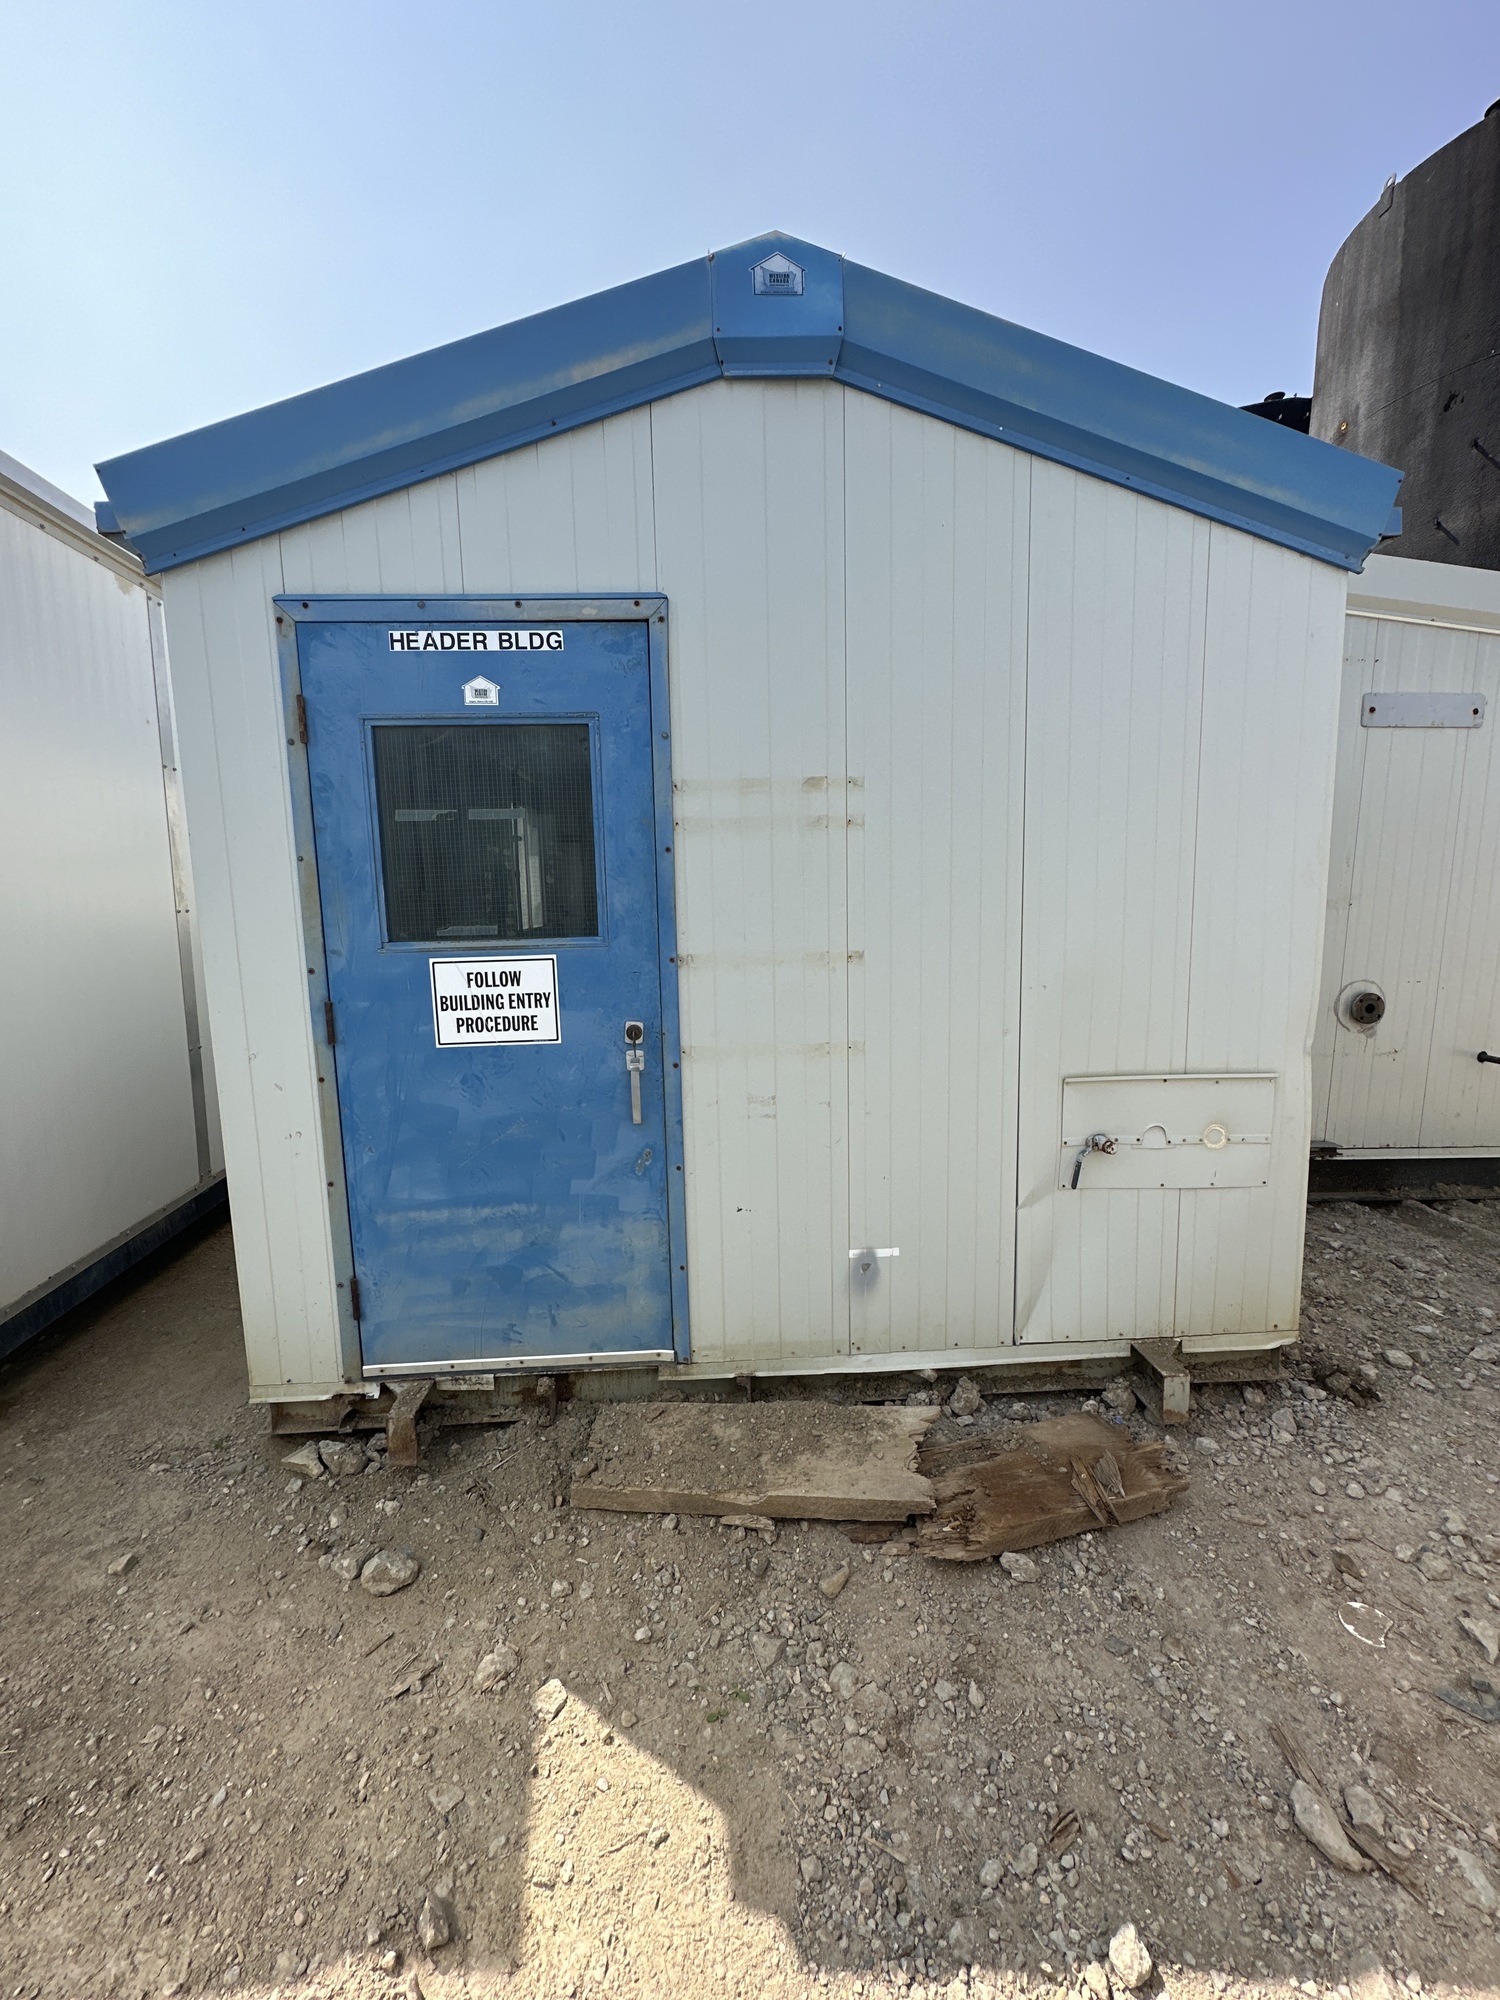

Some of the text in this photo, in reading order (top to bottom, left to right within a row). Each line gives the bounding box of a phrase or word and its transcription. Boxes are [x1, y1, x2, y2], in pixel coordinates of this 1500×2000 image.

[389, 632, 563, 650] HEADER BLDG
[466, 970, 521, 988] FOLLOW
[440, 992, 551, 1012] BUILDING ENTRY
[456, 1015, 538, 1033] PROCEDURE
